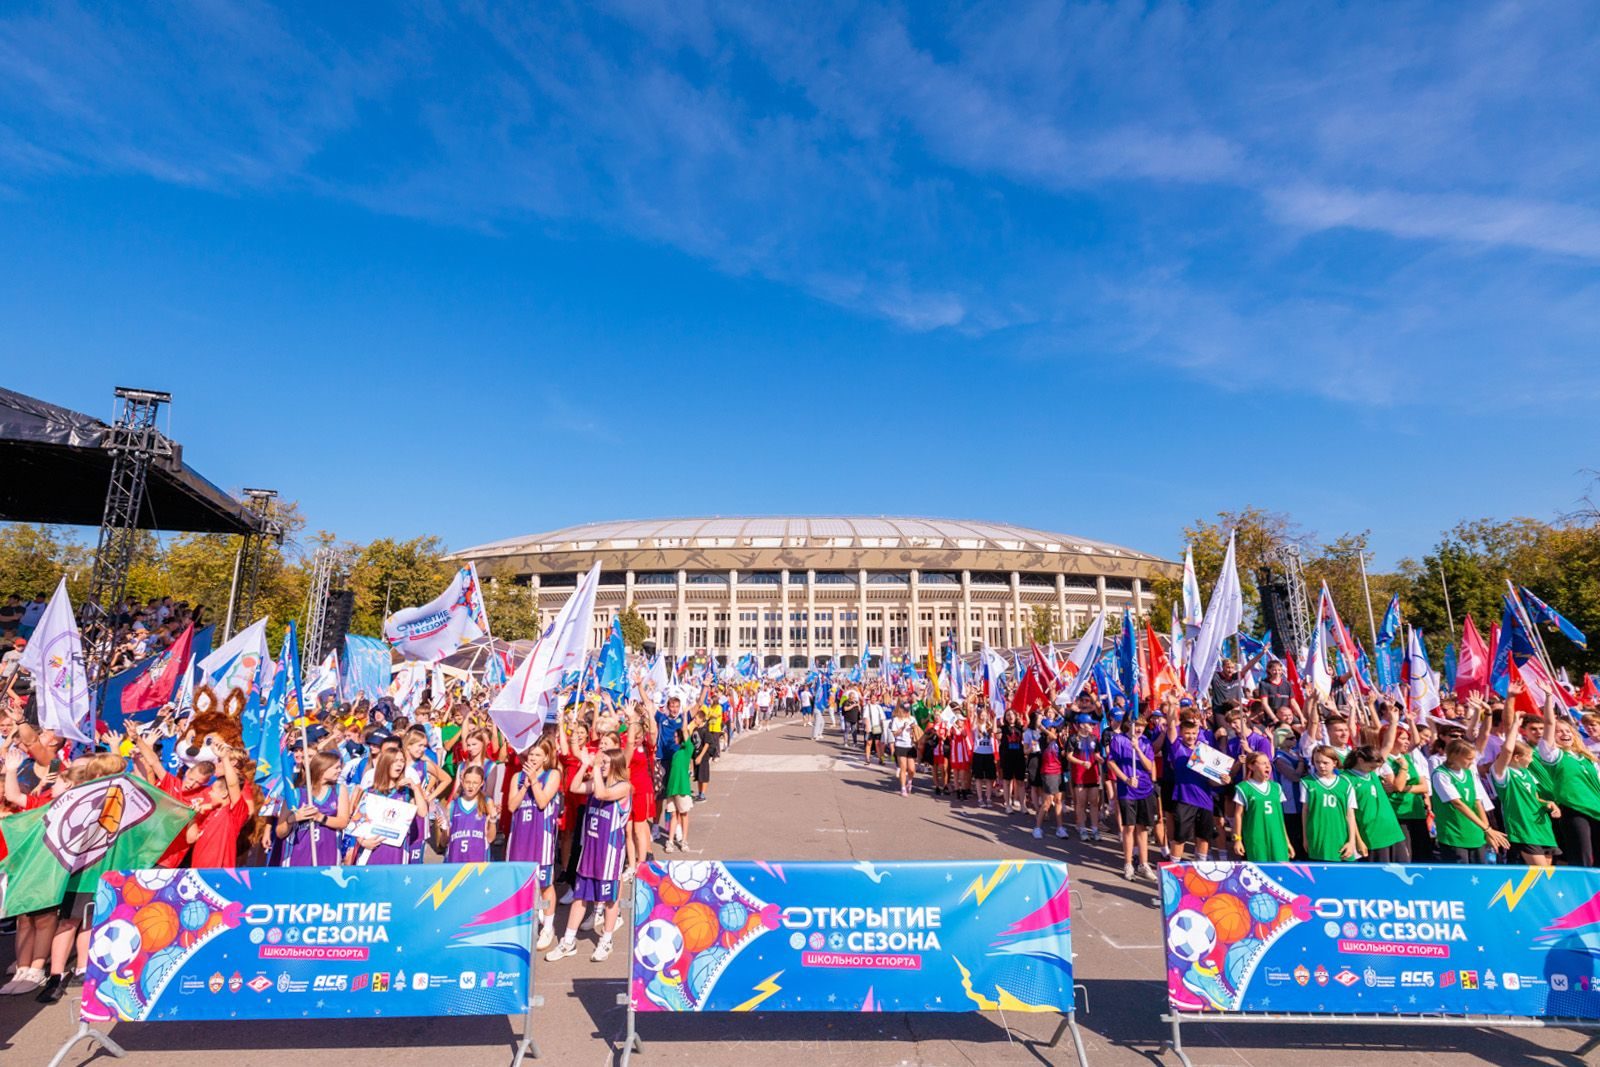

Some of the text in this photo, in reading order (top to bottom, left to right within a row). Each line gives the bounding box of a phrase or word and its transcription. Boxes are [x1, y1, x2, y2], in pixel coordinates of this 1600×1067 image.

[396, 609, 449, 632] ОТКРЫТИЕ
[1322, 793, 1337, 808] 10
[1264, 801, 1273, 814] 5
[522, 809, 533, 822] 16
[590, 816, 599, 830] 12
[460, 840, 469, 853] 5
[411, 849, 421, 860] 15
[601, 883, 611, 896] 12
[245, 902, 392, 924] ОТКРЫТИЕ
[1314, 898, 1466, 920] ОТКРЫТИЕ
[782, 906, 942, 929] ОТКРЫТИЕ
[302, 925, 389, 944] СЕЗОНА
[1378, 921, 1468, 942] СЕЗОНА
[847, 931, 942, 951] СЕЗОНА
[264, 947, 364, 958] ШКОЛЬНОГО СПОРТА
[1342, 941, 1445, 955] ШКОЛЬНОГО СПОРТА
[807, 954, 916, 967] ШКОЛЬНОГО СПОРТА
[313, 975, 348, 988] АСБ
[462, 976, 474, 985] VK
[497, 971, 520, 980] Другое
[1401, 971, 1434, 984] АСБ
[496, 979, 513, 987] Дело
[1553, 978, 1565, 987] VK
